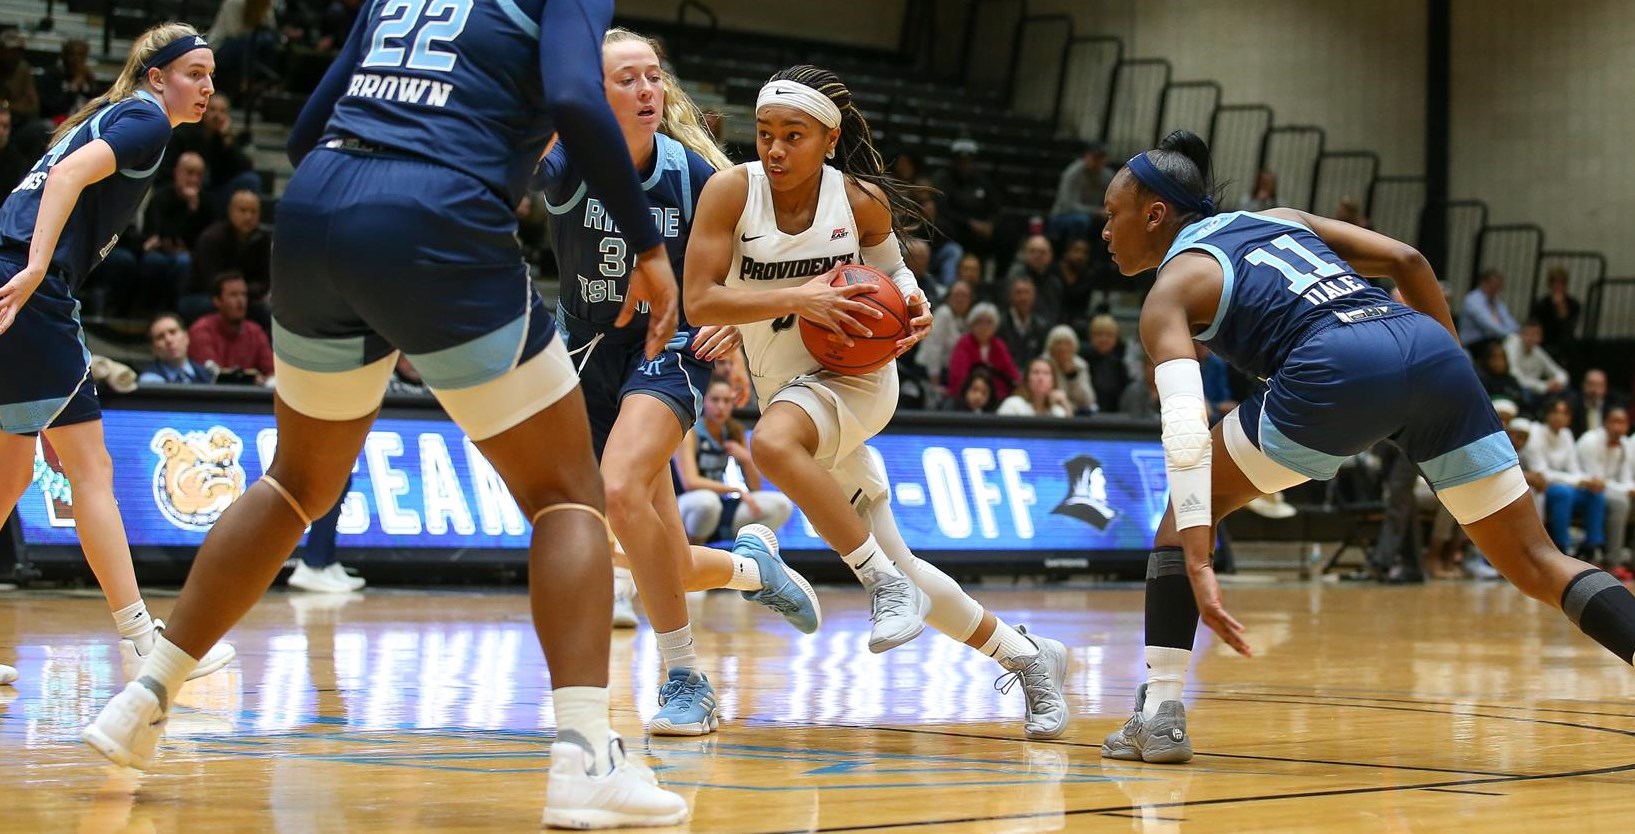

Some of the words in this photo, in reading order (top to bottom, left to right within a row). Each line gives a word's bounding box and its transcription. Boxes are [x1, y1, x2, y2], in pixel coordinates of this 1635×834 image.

[361, 0, 474, 72] 22
[346, 74, 453, 107] BROWN
[31, 119, 88, 171] 4
[584, 198, 679, 237] RDE
[1244, 233, 1346, 295] 11
[1303, 275, 1366, 306] DALE
